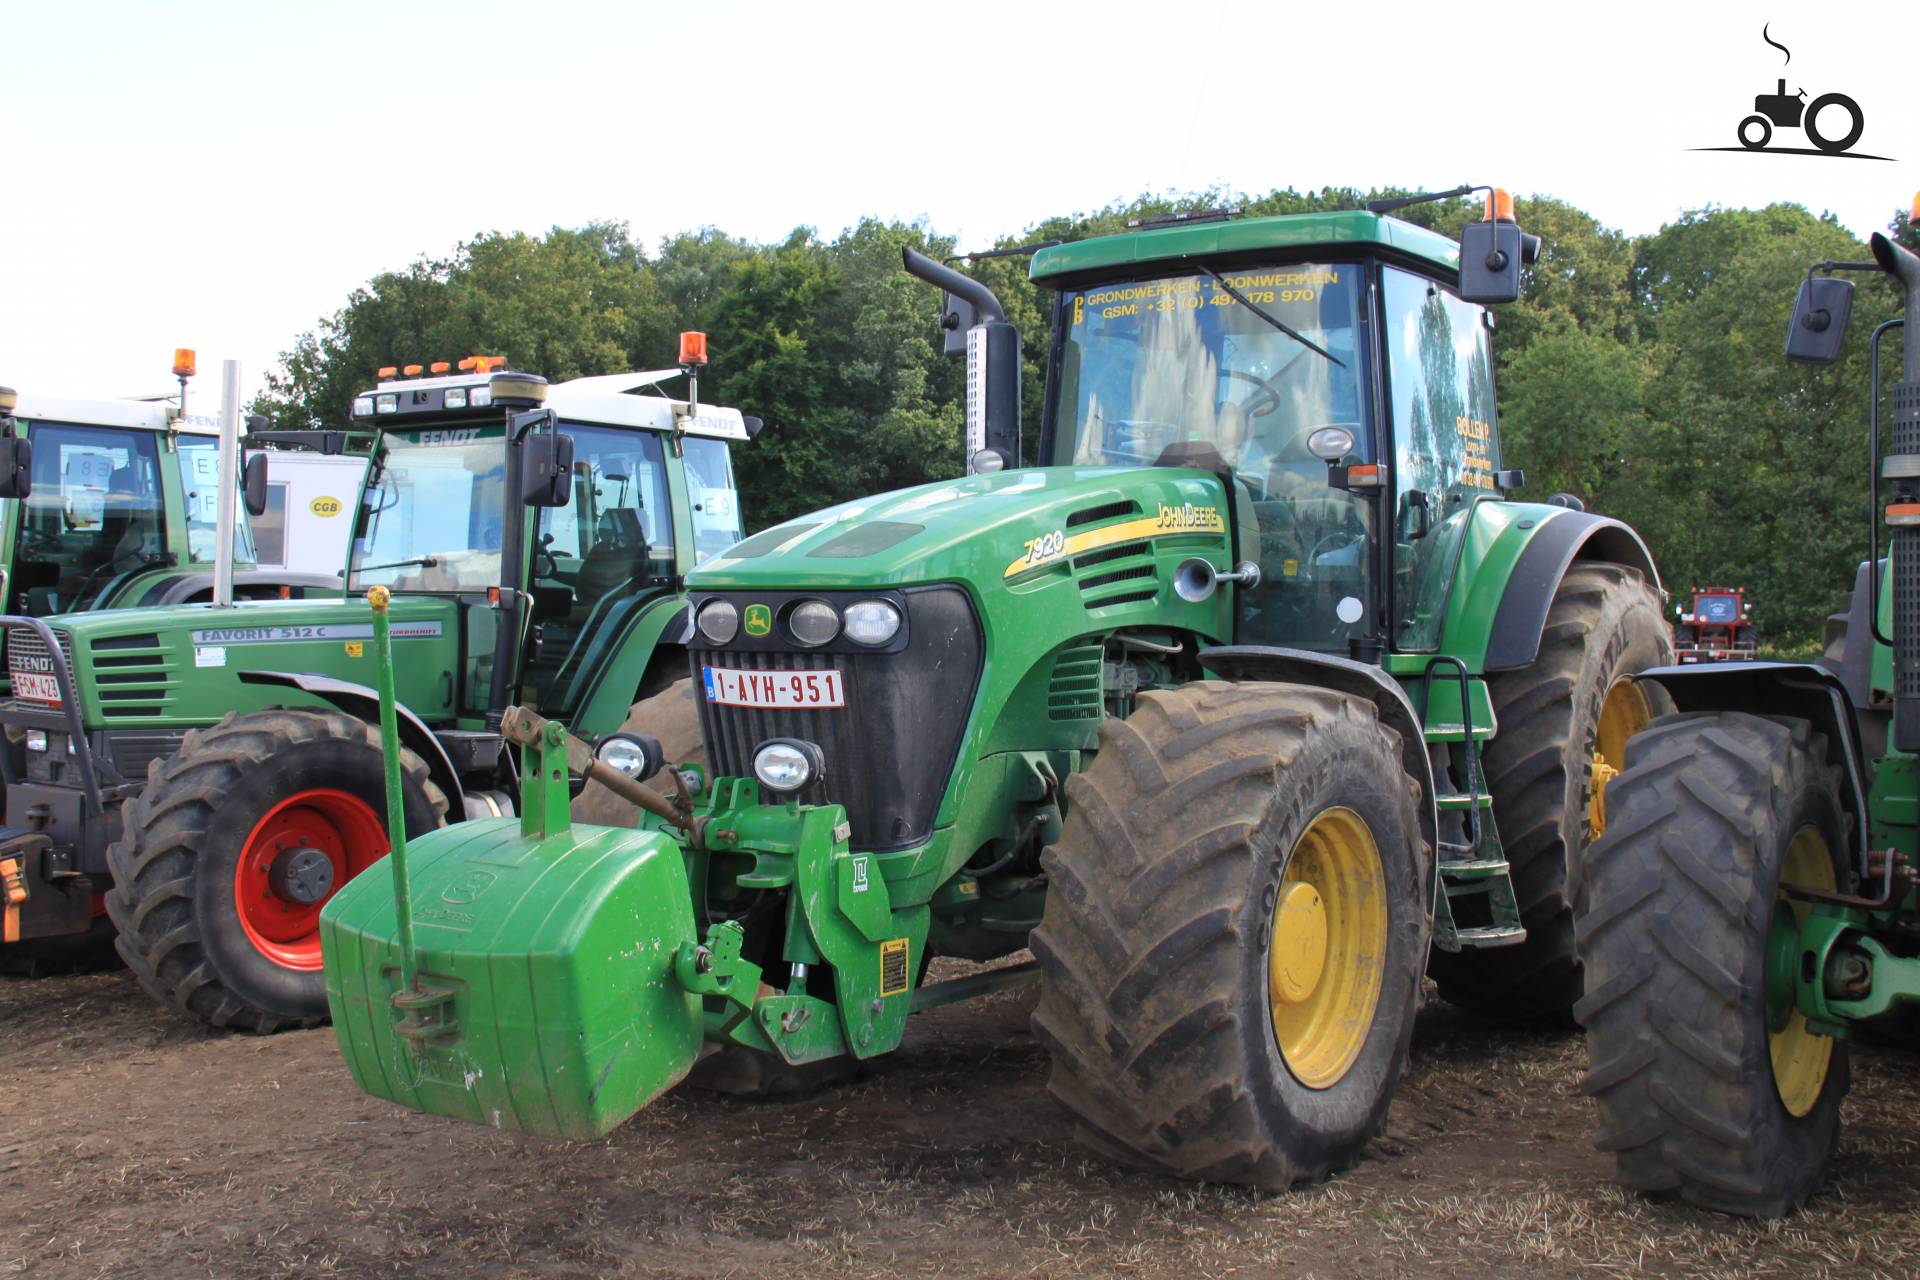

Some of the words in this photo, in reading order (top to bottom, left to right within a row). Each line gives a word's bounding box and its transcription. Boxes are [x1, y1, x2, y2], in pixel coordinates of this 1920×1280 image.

[1087, 280, 1200, 306] GRONDWERKEN
[1102, 304, 1139, 319] GSM:
[1247, 291, 1276, 304] 178
[1281, 289, 1315, 302] 970
[419, 429, 480, 447] FENDT
[313, 502, 337, 512] CGB
[1157, 502, 1187, 528] JOHN
[1185, 502, 1218, 527] DEERE
[1023, 530, 1065, 562] 7920
[201, 627, 275, 641] FAVORIT
[281, 627, 313, 638] 512
[316, 627, 326, 637] C
[717, 672, 836, 703] 1-AYH-951
